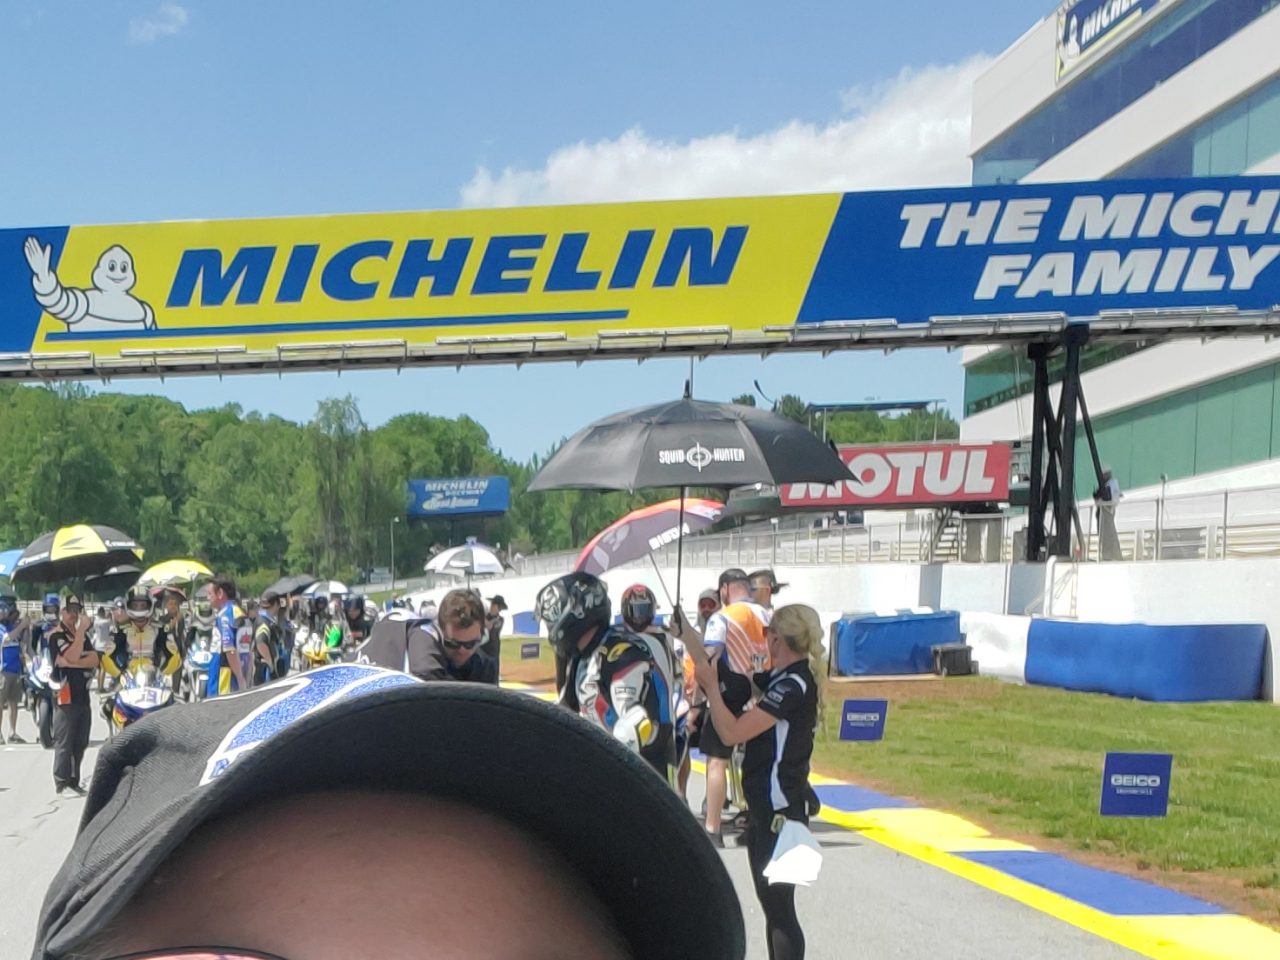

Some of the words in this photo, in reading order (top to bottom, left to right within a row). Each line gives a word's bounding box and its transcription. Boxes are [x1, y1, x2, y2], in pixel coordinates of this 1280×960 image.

[899, 198, 1051, 249] THE
[1058, 189, 1280, 241] MICH
[165, 225, 750, 308] MICHELIN
[973, 245, 1280, 301] FAMILY
[658, 449, 685, 465] SQUID
[713, 447, 745, 462] HUNTER
[1110, 773, 1161, 788] GEICO
